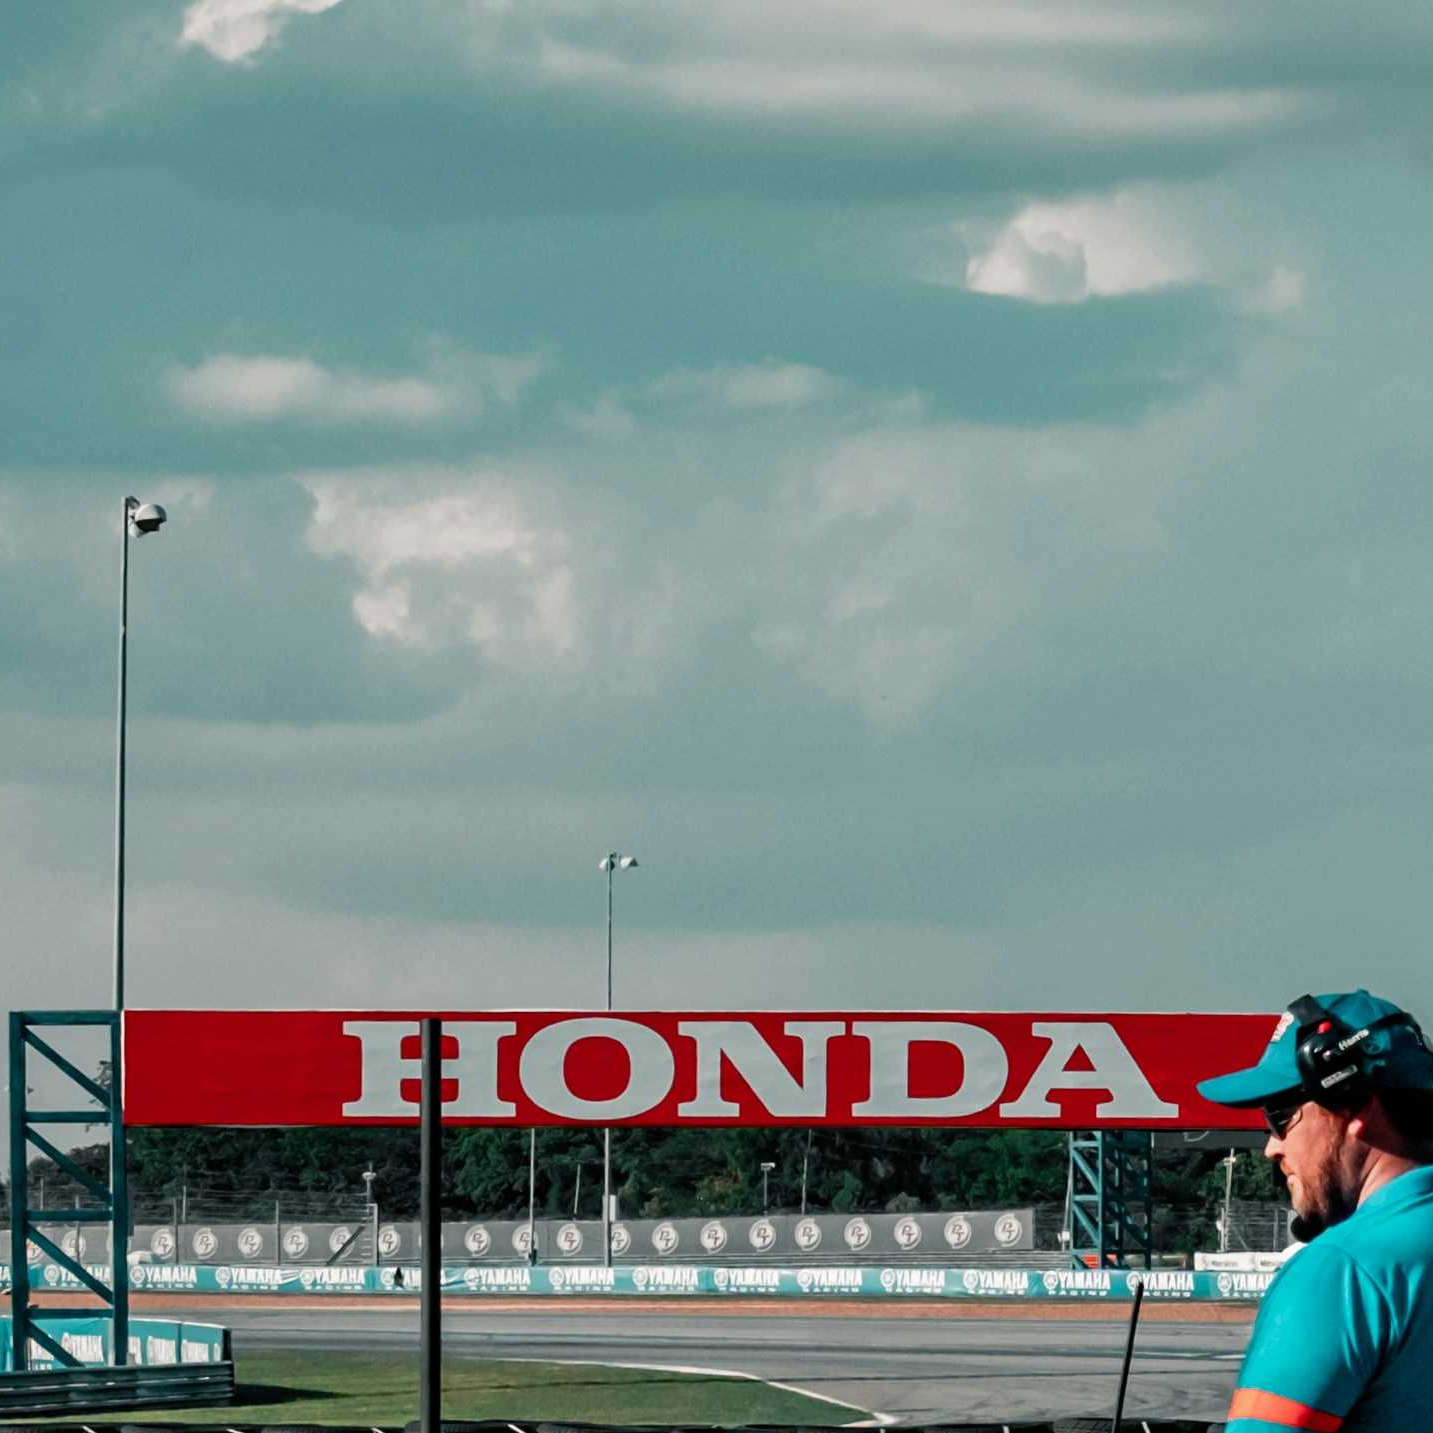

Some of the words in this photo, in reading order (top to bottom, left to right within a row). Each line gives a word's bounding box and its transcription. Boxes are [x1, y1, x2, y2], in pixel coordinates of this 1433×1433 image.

[343, 1018, 1179, 1120] HONDA
[144, 1267, 197, 1282] YAMAHA
[231, 1268, 281, 1284] YAMAHA
[314, 1267, 365, 1283] YAMAHA
[478, 1268, 530, 1284] YAMAHA
[564, 1268, 615, 1284] YAMAHA
[647, 1267, 699, 1285] YAMAHA
[729, 1269, 780, 1286] YAMAHA
[812, 1269, 862, 1286] YAMAHA
[895, 1270, 945, 1288] YAMAHA
[978, 1271, 1028, 1290] YAMAHA
[1059, 1270, 1111, 1289] YAMAHA
[1142, 1272, 1194, 1290] YAMAHA
